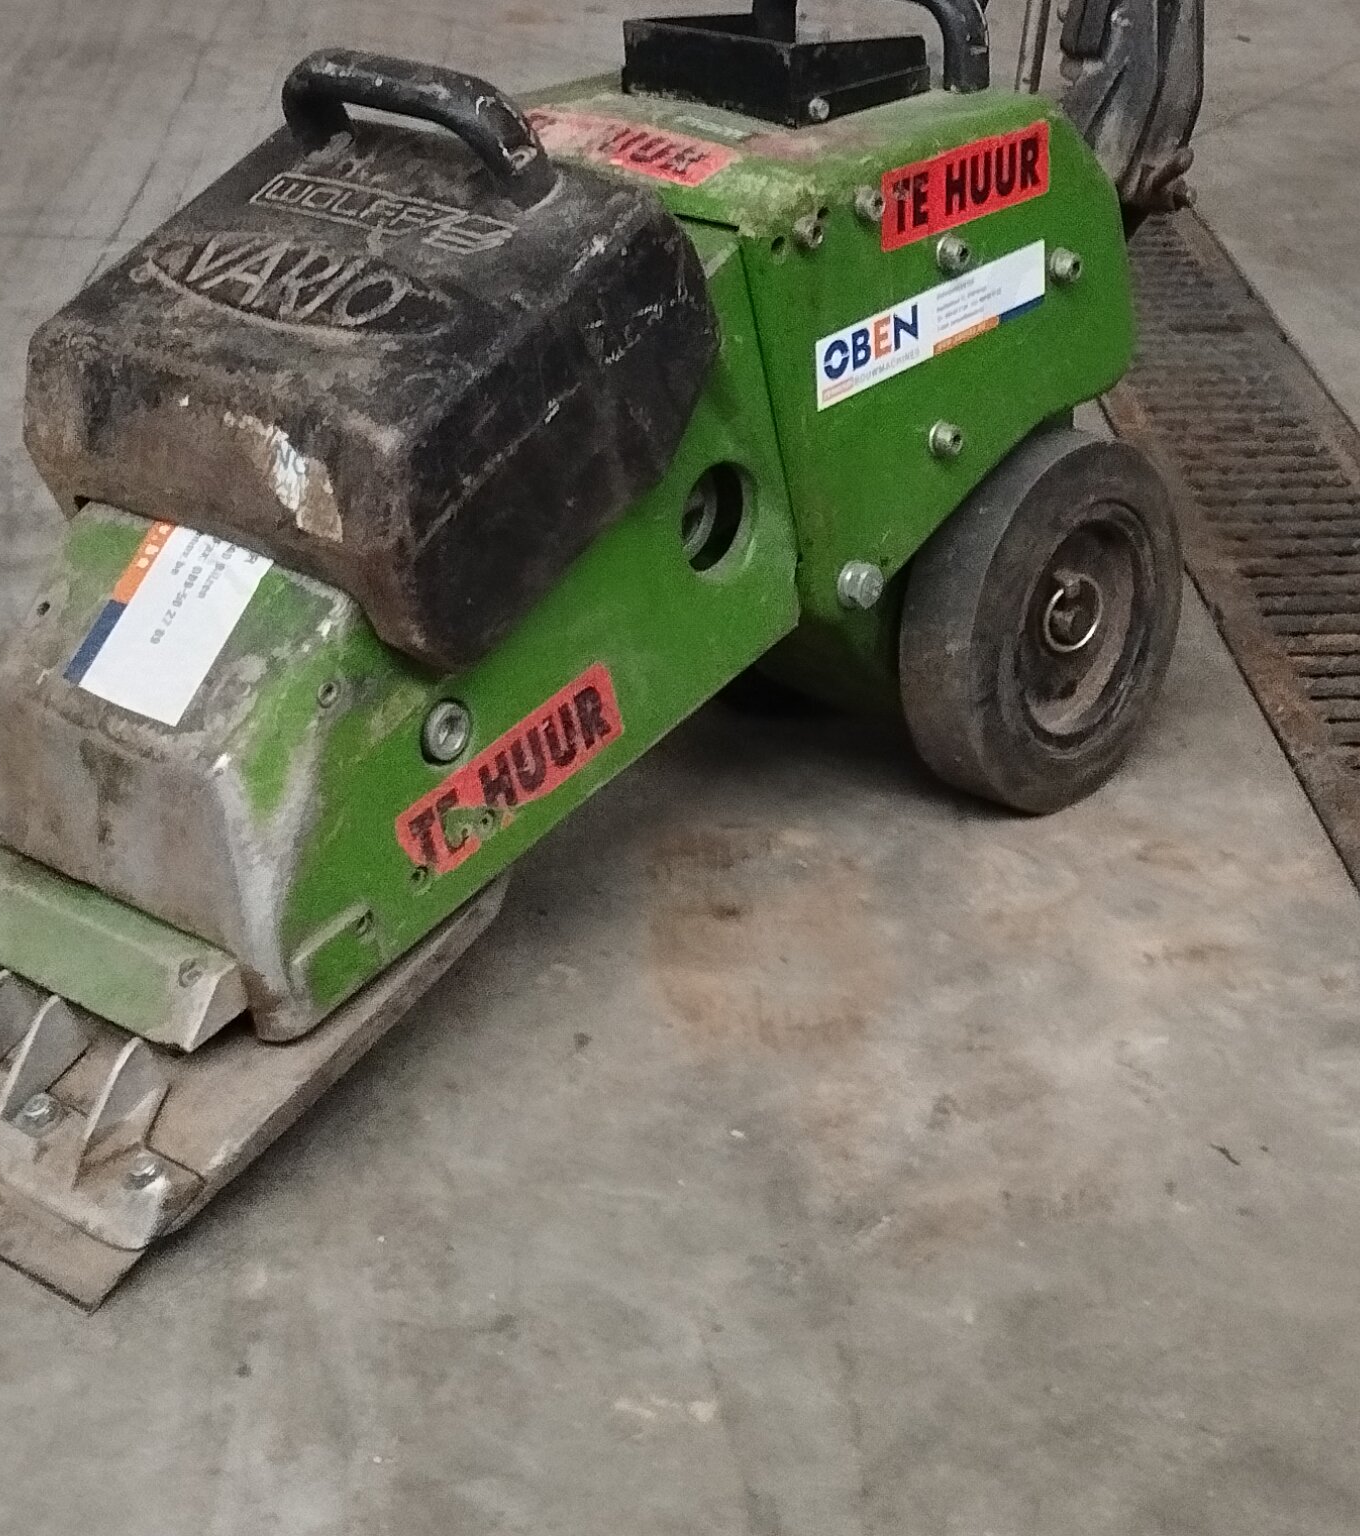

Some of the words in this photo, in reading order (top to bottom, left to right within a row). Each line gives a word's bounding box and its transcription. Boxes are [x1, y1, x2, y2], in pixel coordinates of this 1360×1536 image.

[265, 178, 438, 228] WOLFF
[892, 171, 929, 235] TE
[944, 132, 1041, 217] HUUR
[186, 236, 413, 327] VARIO
[823, 301, 919, 380] OBEN
[478, 685, 613, 808] HUUR
